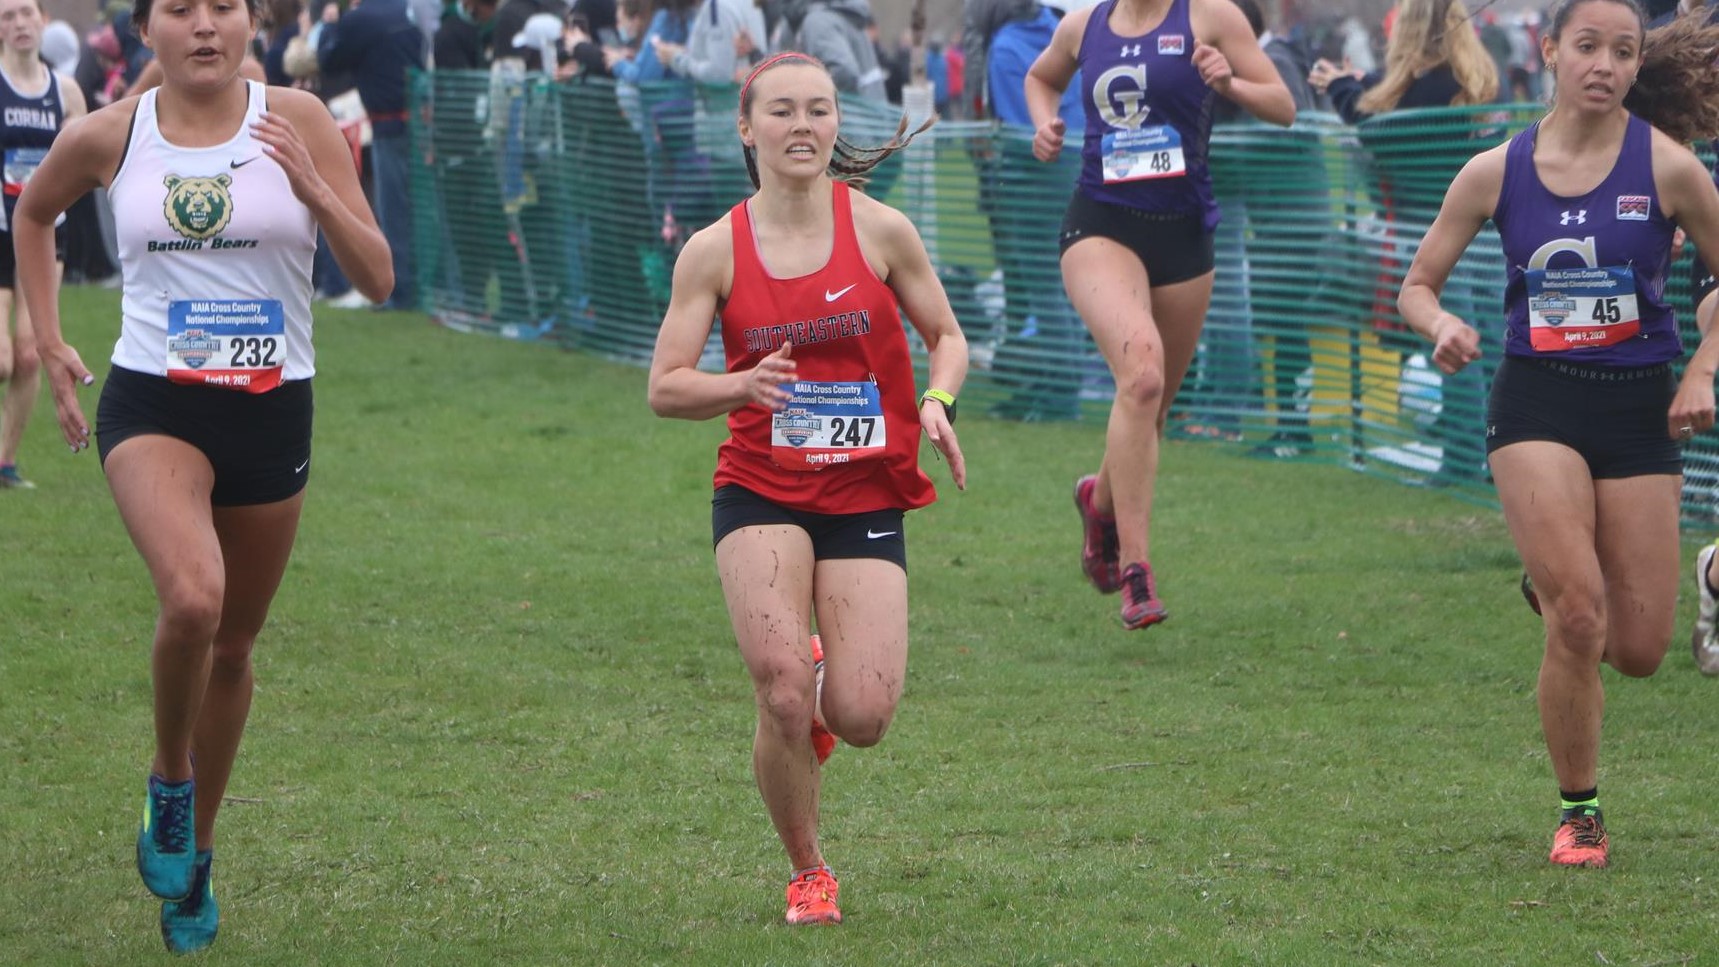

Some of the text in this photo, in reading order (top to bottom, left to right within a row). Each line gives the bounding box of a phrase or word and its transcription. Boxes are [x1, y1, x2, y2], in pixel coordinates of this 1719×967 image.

[4, 107, 56, 131] CORBAN
[1151, 152, 1171, 173] 48
[210, 238, 259, 250] Bears
[191, 303, 262, 314] NAIA Cross Country
[1592, 298, 1621, 324] 45
[186, 315, 269, 327] National Championships
[744, 310, 871, 353] SOUTHEASTERN
[230, 337, 277, 368] 232
[794, 383, 862, 395] NAIA Cross Country
[817, 396, 868, 406] Championships
[830, 417, 876, 447] 247
[805, 454, 849, 464] April 9, 2021
